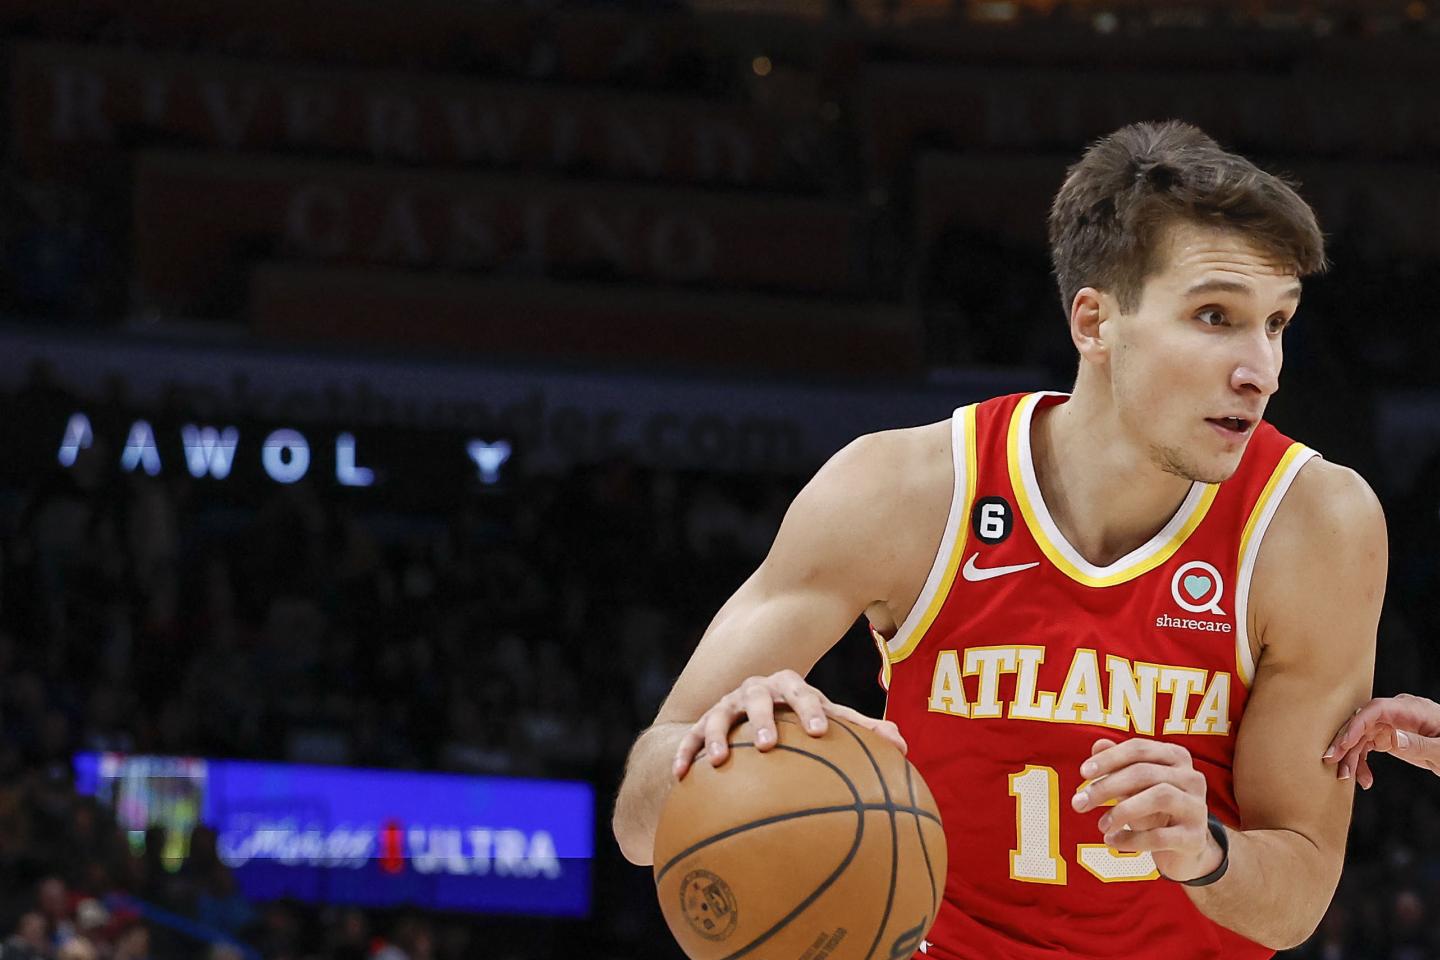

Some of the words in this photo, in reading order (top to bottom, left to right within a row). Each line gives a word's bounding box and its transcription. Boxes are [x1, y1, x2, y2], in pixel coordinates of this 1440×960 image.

[979, 503, 1006, 539] 6
[1155, 614, 1232, 634] sharecare
[928, 644, 1232, 737] ATLANTA
